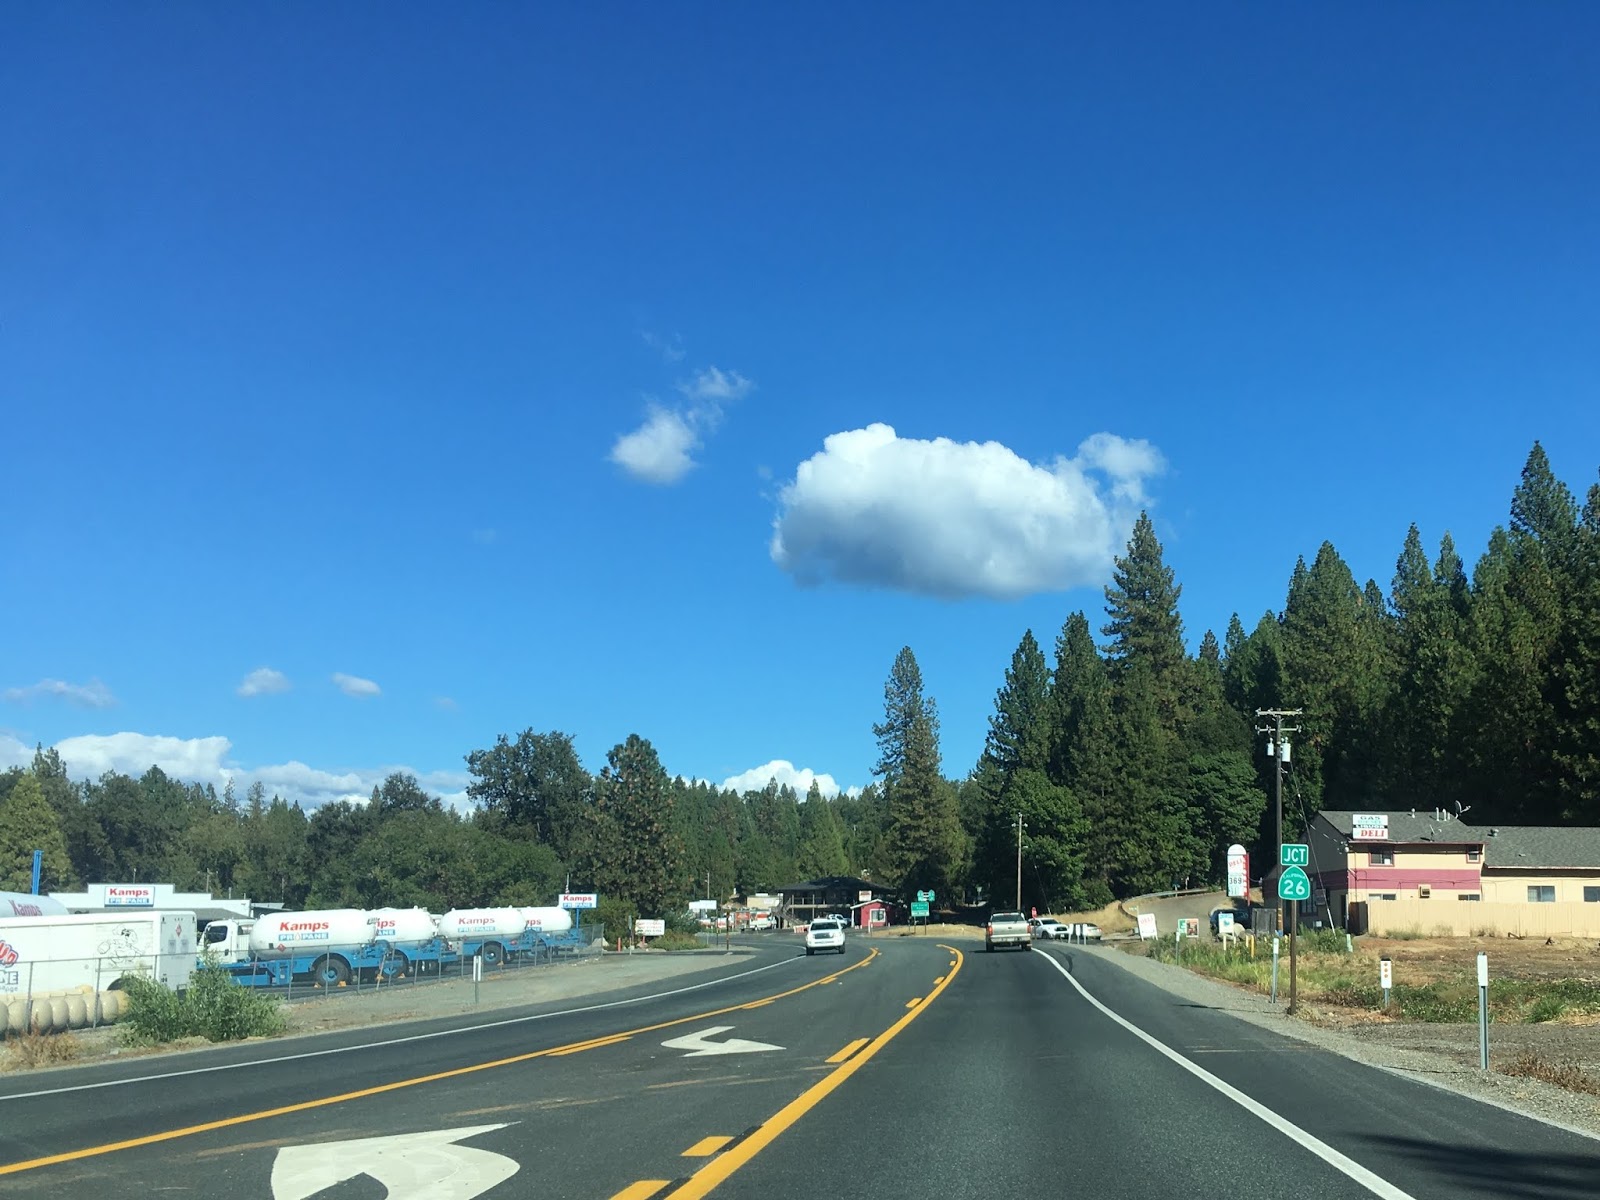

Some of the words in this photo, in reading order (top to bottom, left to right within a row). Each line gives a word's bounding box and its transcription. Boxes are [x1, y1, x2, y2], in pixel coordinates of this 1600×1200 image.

[1283, 848, 1306, 862] JCT
[109, 888, 149, 897] Kamps
[1283, 880, 1306, 895] 26
[280, 921, 329, 932] Kamps
[458, 917, 496, 925] Kamps
